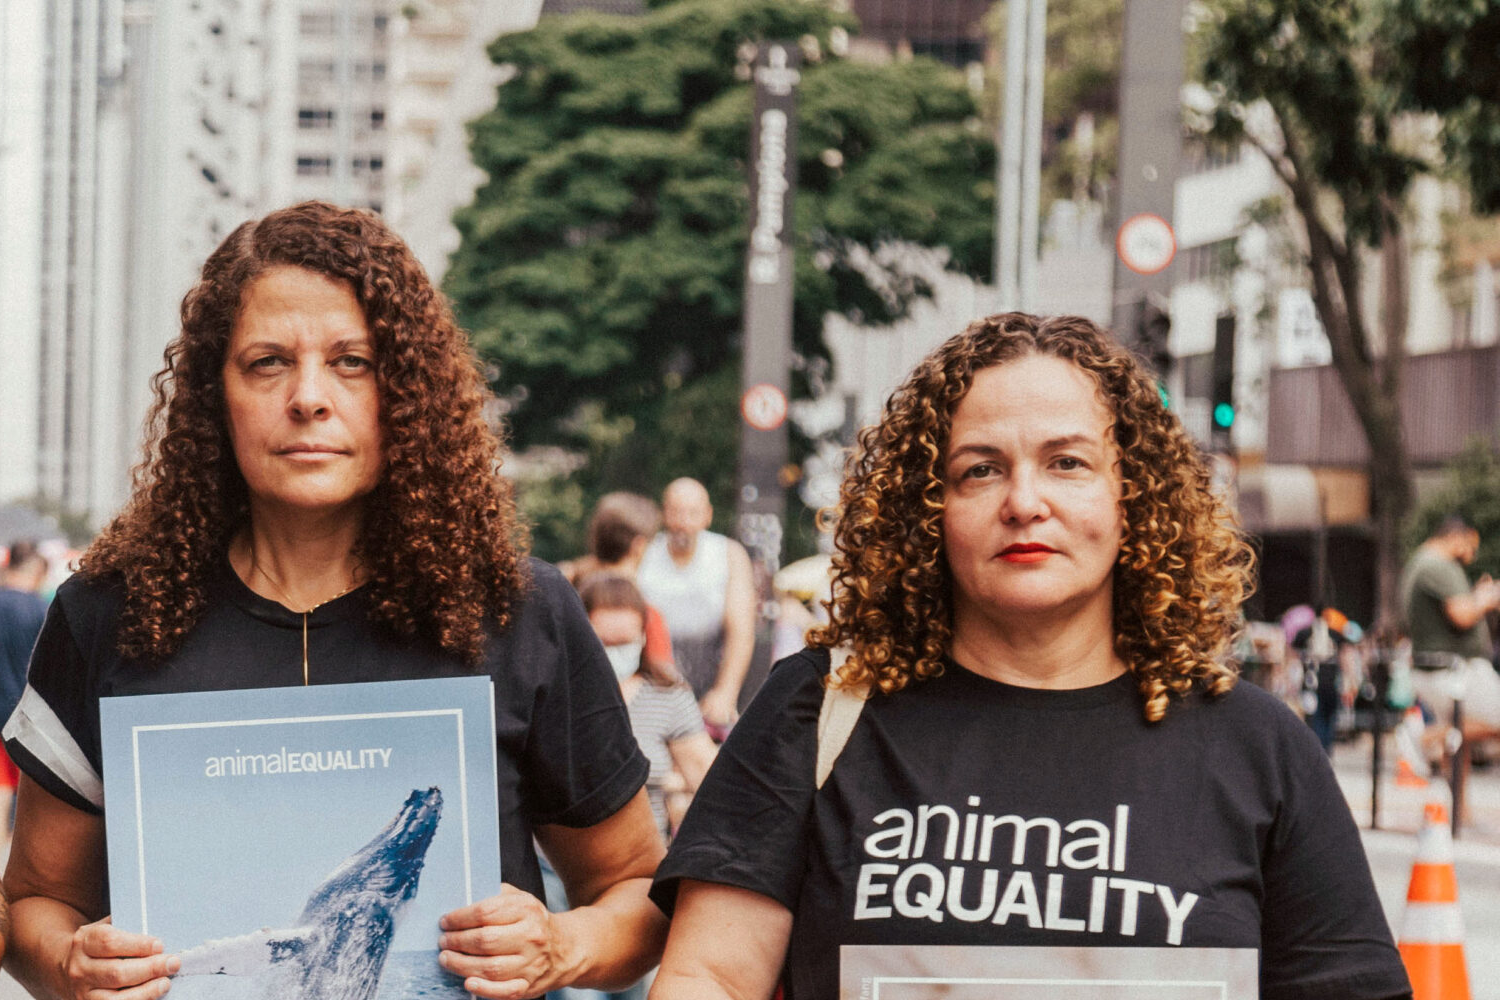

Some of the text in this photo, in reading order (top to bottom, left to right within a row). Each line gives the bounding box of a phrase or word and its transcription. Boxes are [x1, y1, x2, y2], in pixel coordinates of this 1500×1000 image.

[204, 747, 393, 778] animalEQUALITY
[864, 796, 1130, 872] animal
[853, 863, 1199, 946] EQUALITY
